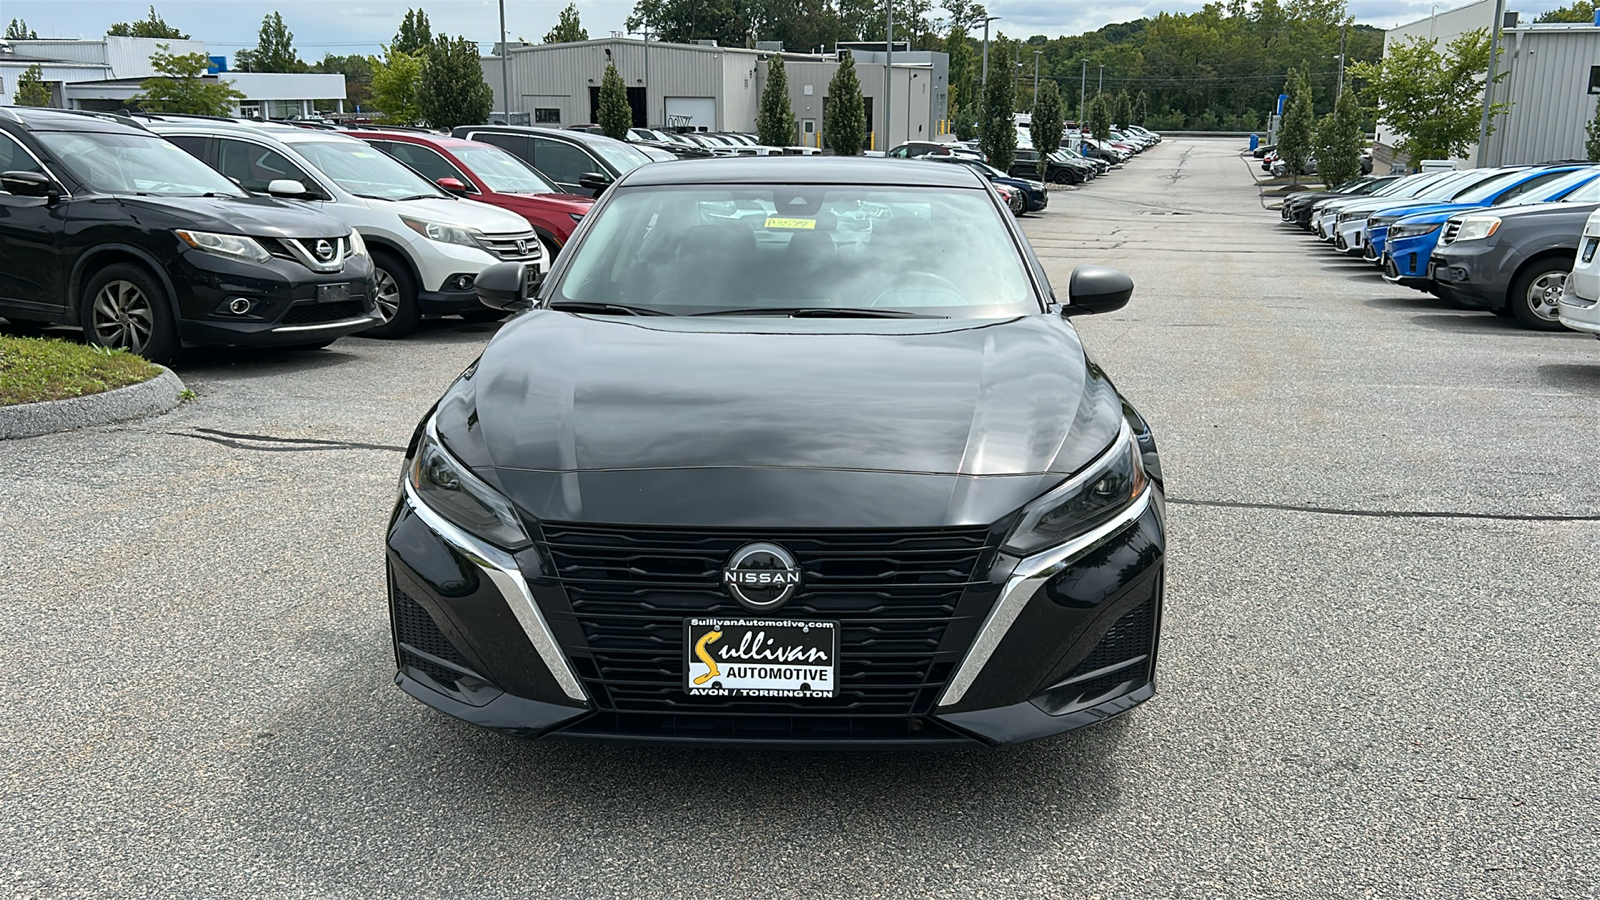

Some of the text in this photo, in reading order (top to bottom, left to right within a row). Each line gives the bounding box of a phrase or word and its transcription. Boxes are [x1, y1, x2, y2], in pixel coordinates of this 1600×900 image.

[725, 572, 799, 583] NISSAN
[691, 619, 834, 629] SullivanAutomotive.com
[693, 630, 828, 685] Sullivan
[726, 667, 828, 681] AUTOMOTIVE
[690, 688, 729, 696] AVON
[741, 689, 833, 698] TORRINGTON
